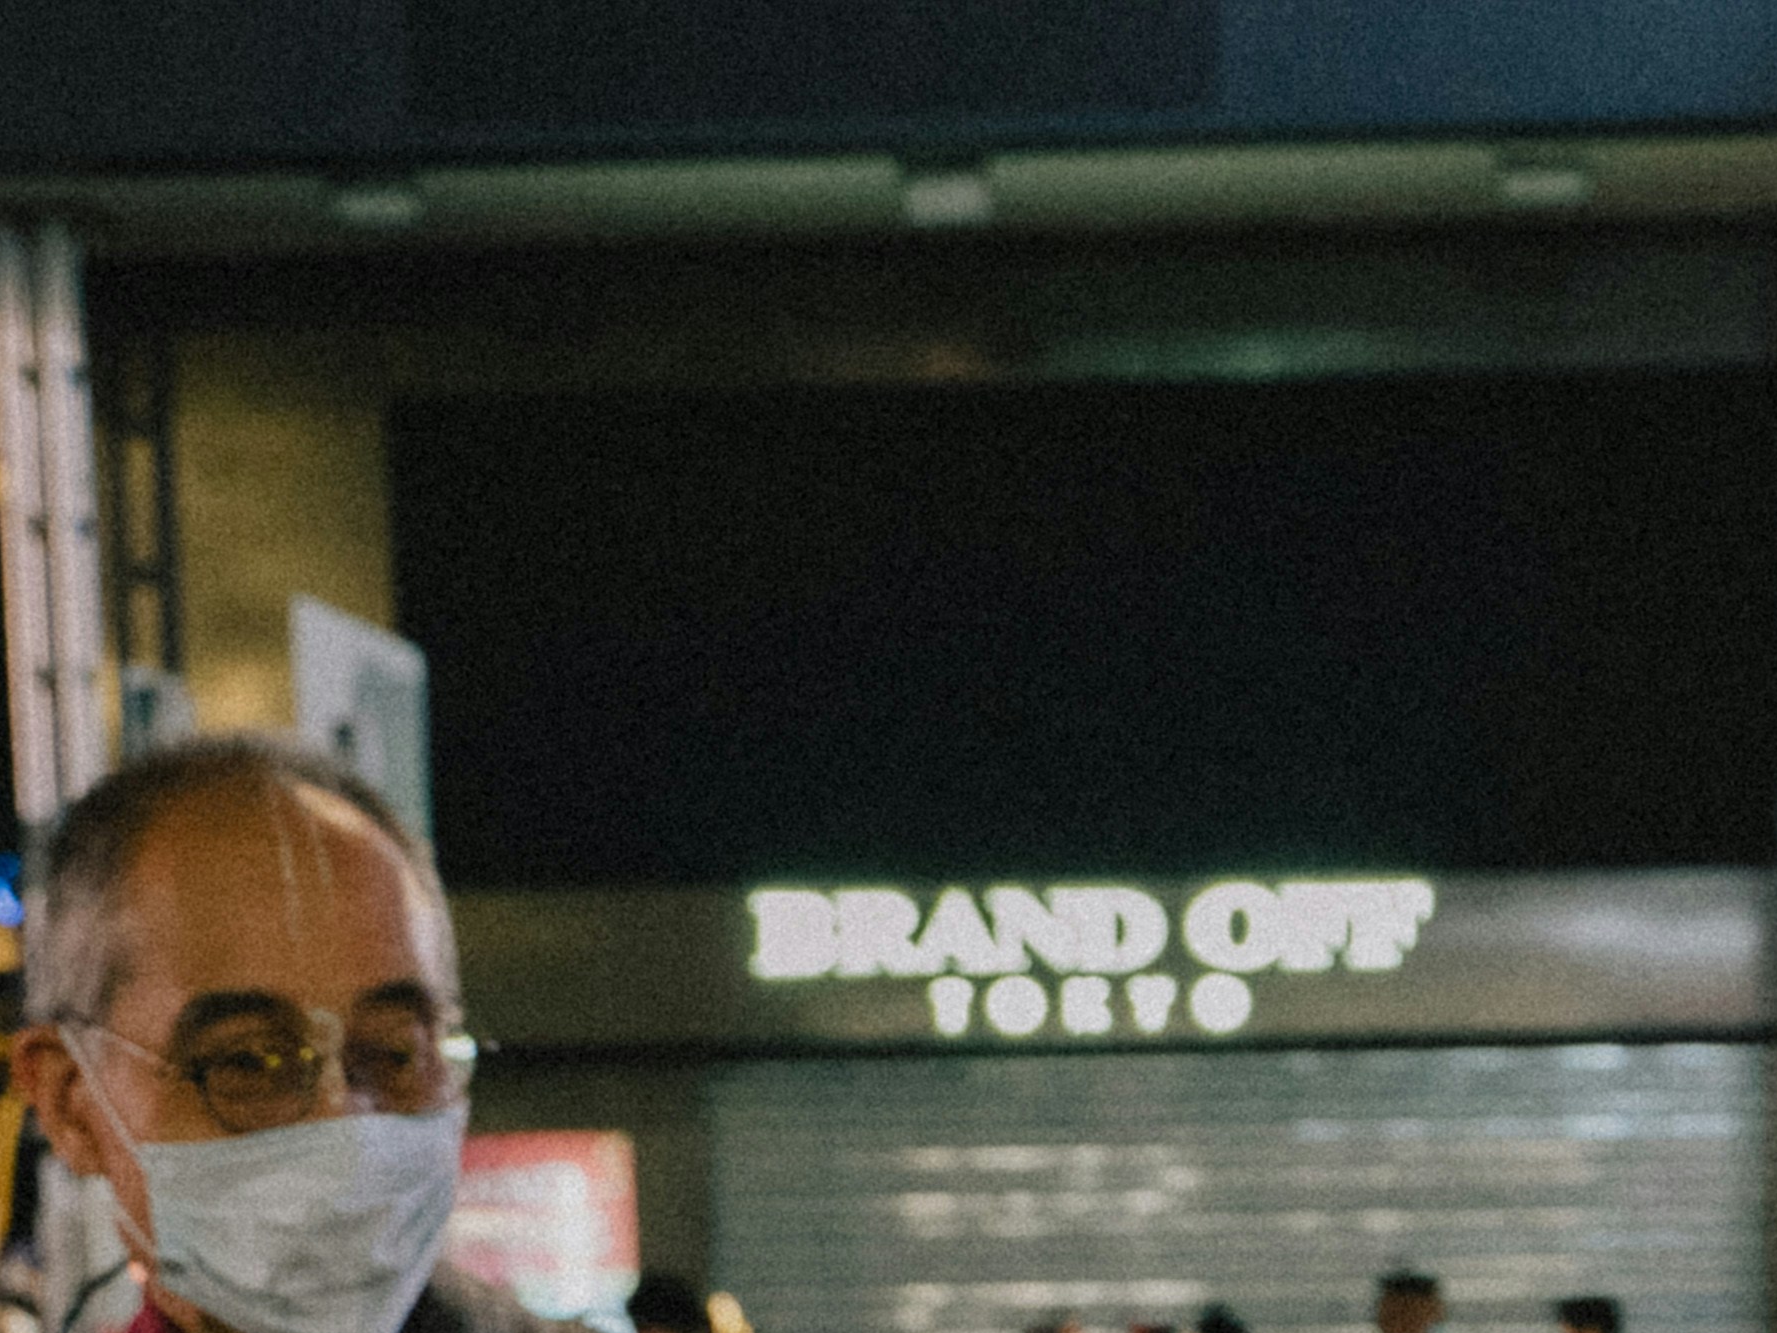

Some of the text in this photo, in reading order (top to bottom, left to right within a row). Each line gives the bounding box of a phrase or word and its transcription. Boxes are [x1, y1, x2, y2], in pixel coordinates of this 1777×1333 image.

[745, 877, 1436, 980] BRAND OFF
[925, 971, 1254, 1037] TOKYO
